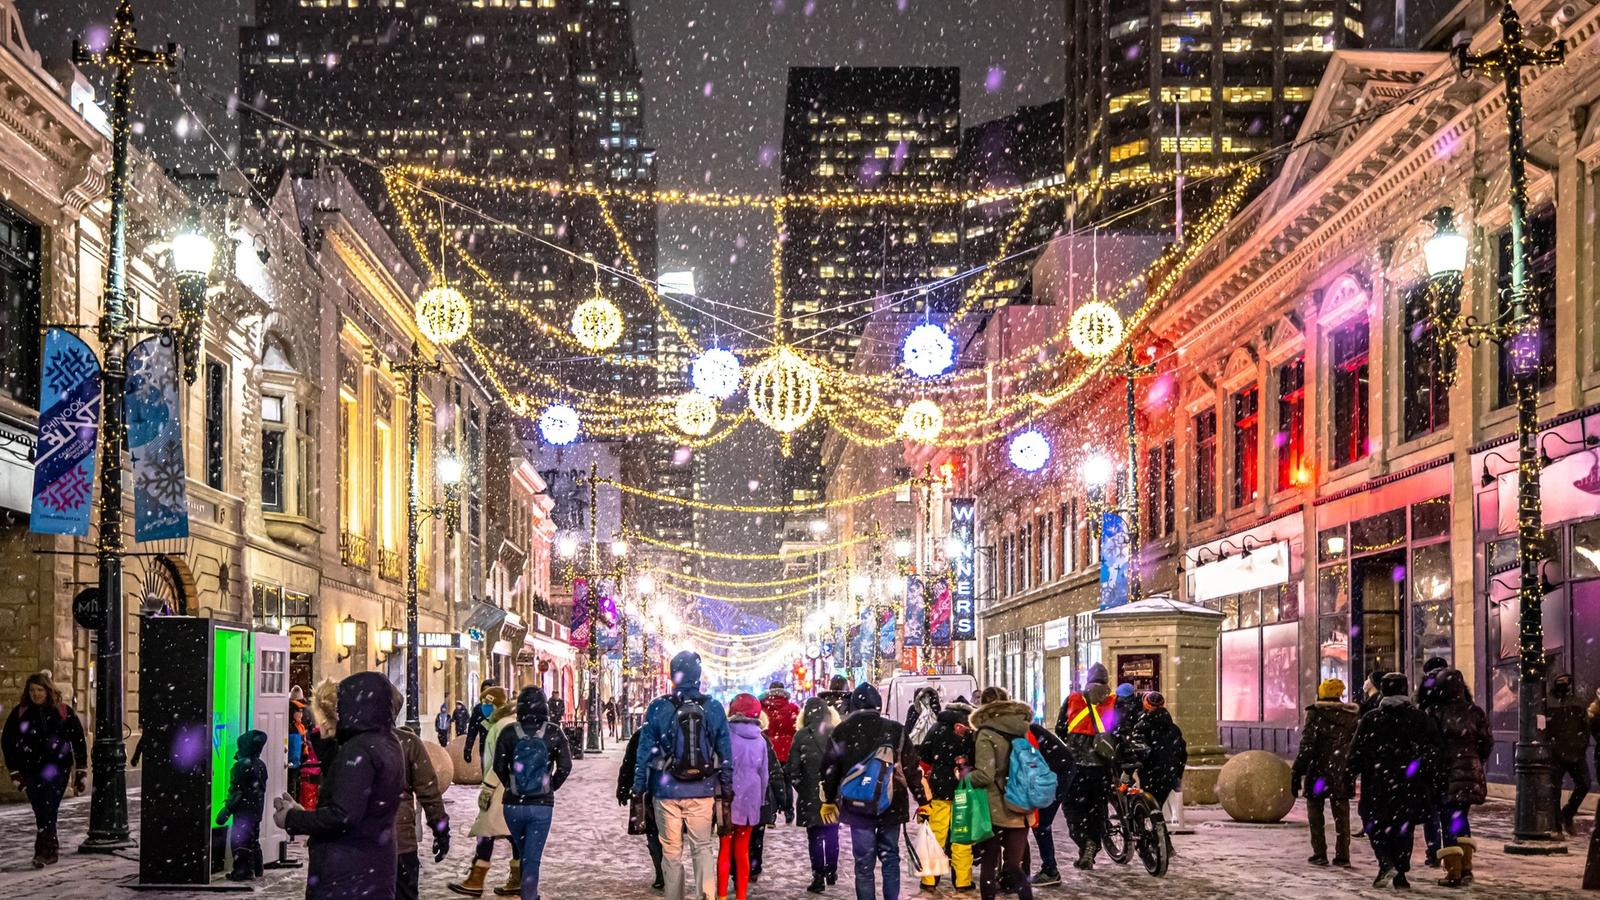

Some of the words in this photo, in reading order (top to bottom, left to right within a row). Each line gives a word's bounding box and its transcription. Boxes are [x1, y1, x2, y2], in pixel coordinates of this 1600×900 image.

[37, 395, 100, 461] BLAST
[41, 397, 85, 434] CHINOOK
[953, 506, 975, 633] WINNERS
